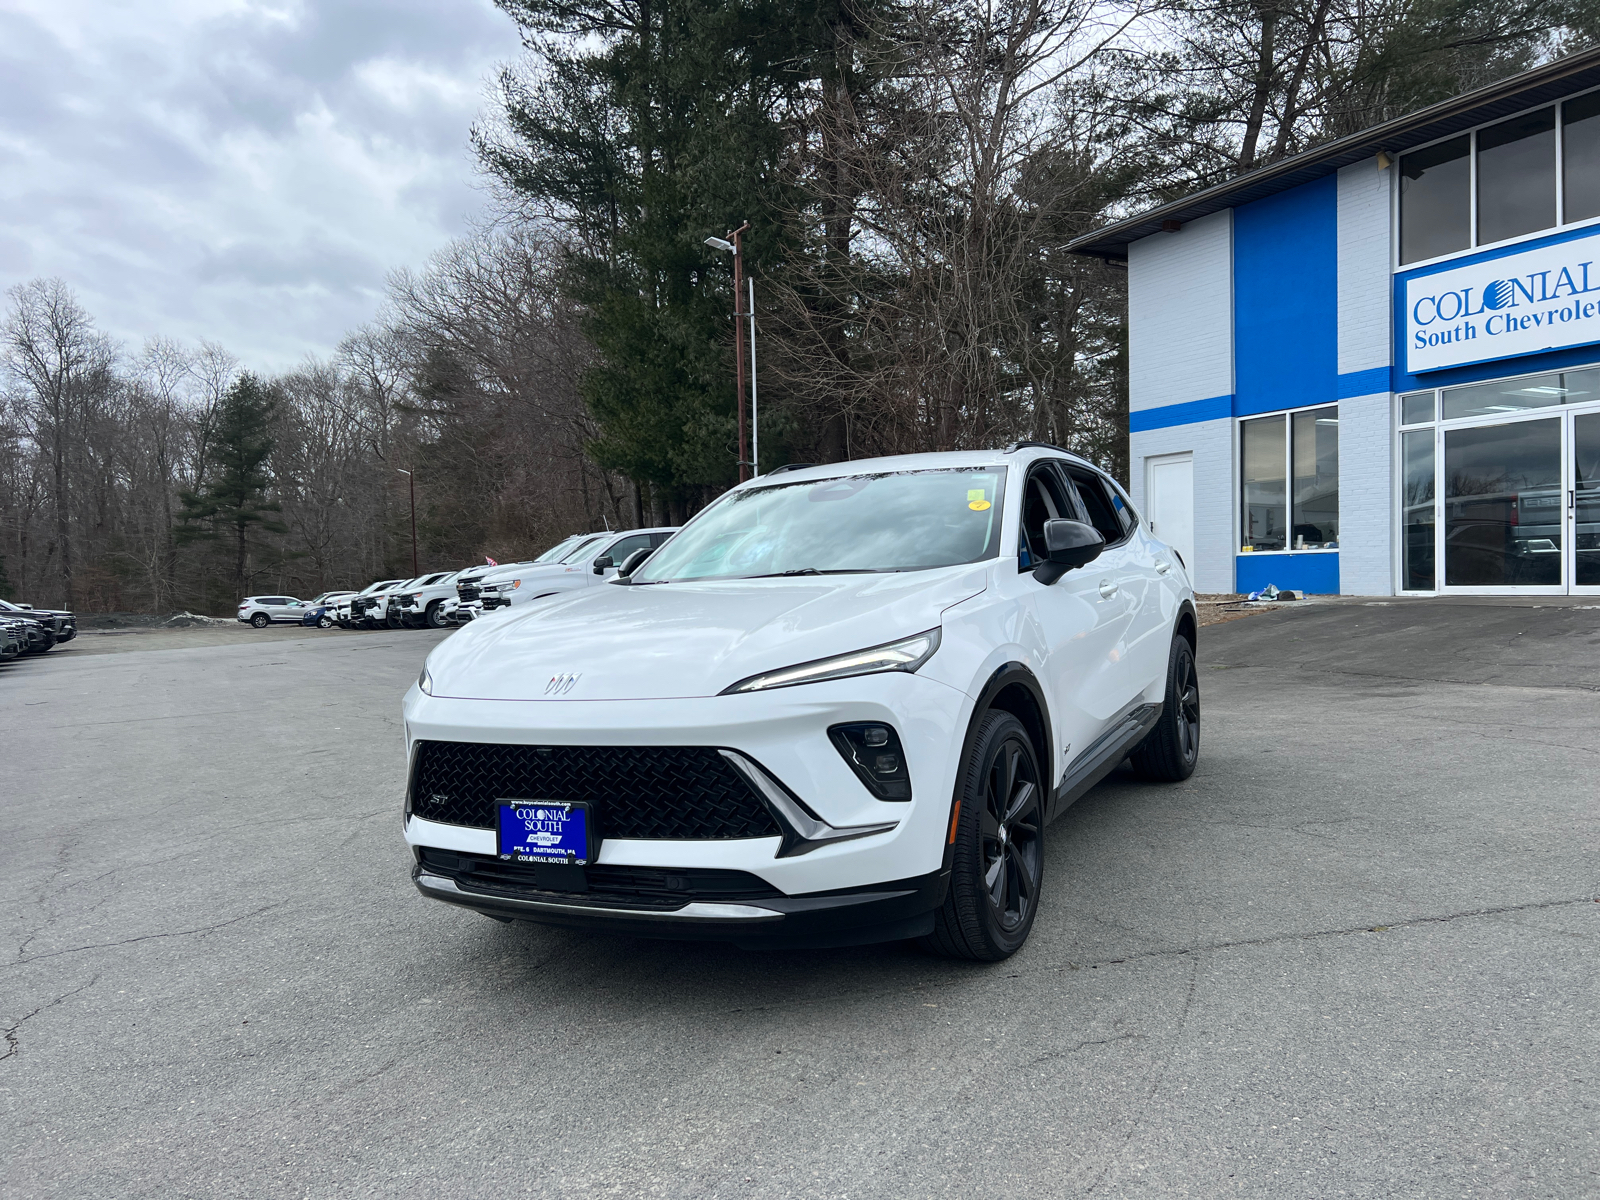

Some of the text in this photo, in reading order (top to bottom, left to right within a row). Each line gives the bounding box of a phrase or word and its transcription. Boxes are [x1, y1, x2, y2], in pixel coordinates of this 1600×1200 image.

[1413, 261, 1600, 325] COLONIAL
[1414, 321, 1477, 350] South
[430, 794, 448, 805] ST
[516, 808, 571, 822] COLONIAL
[524, 820, 562, 832] SOUTH
[533, 847, 566, 855] DARTMOUTH,
[517, 854, 568, 864] COLONIAL SOUTH
